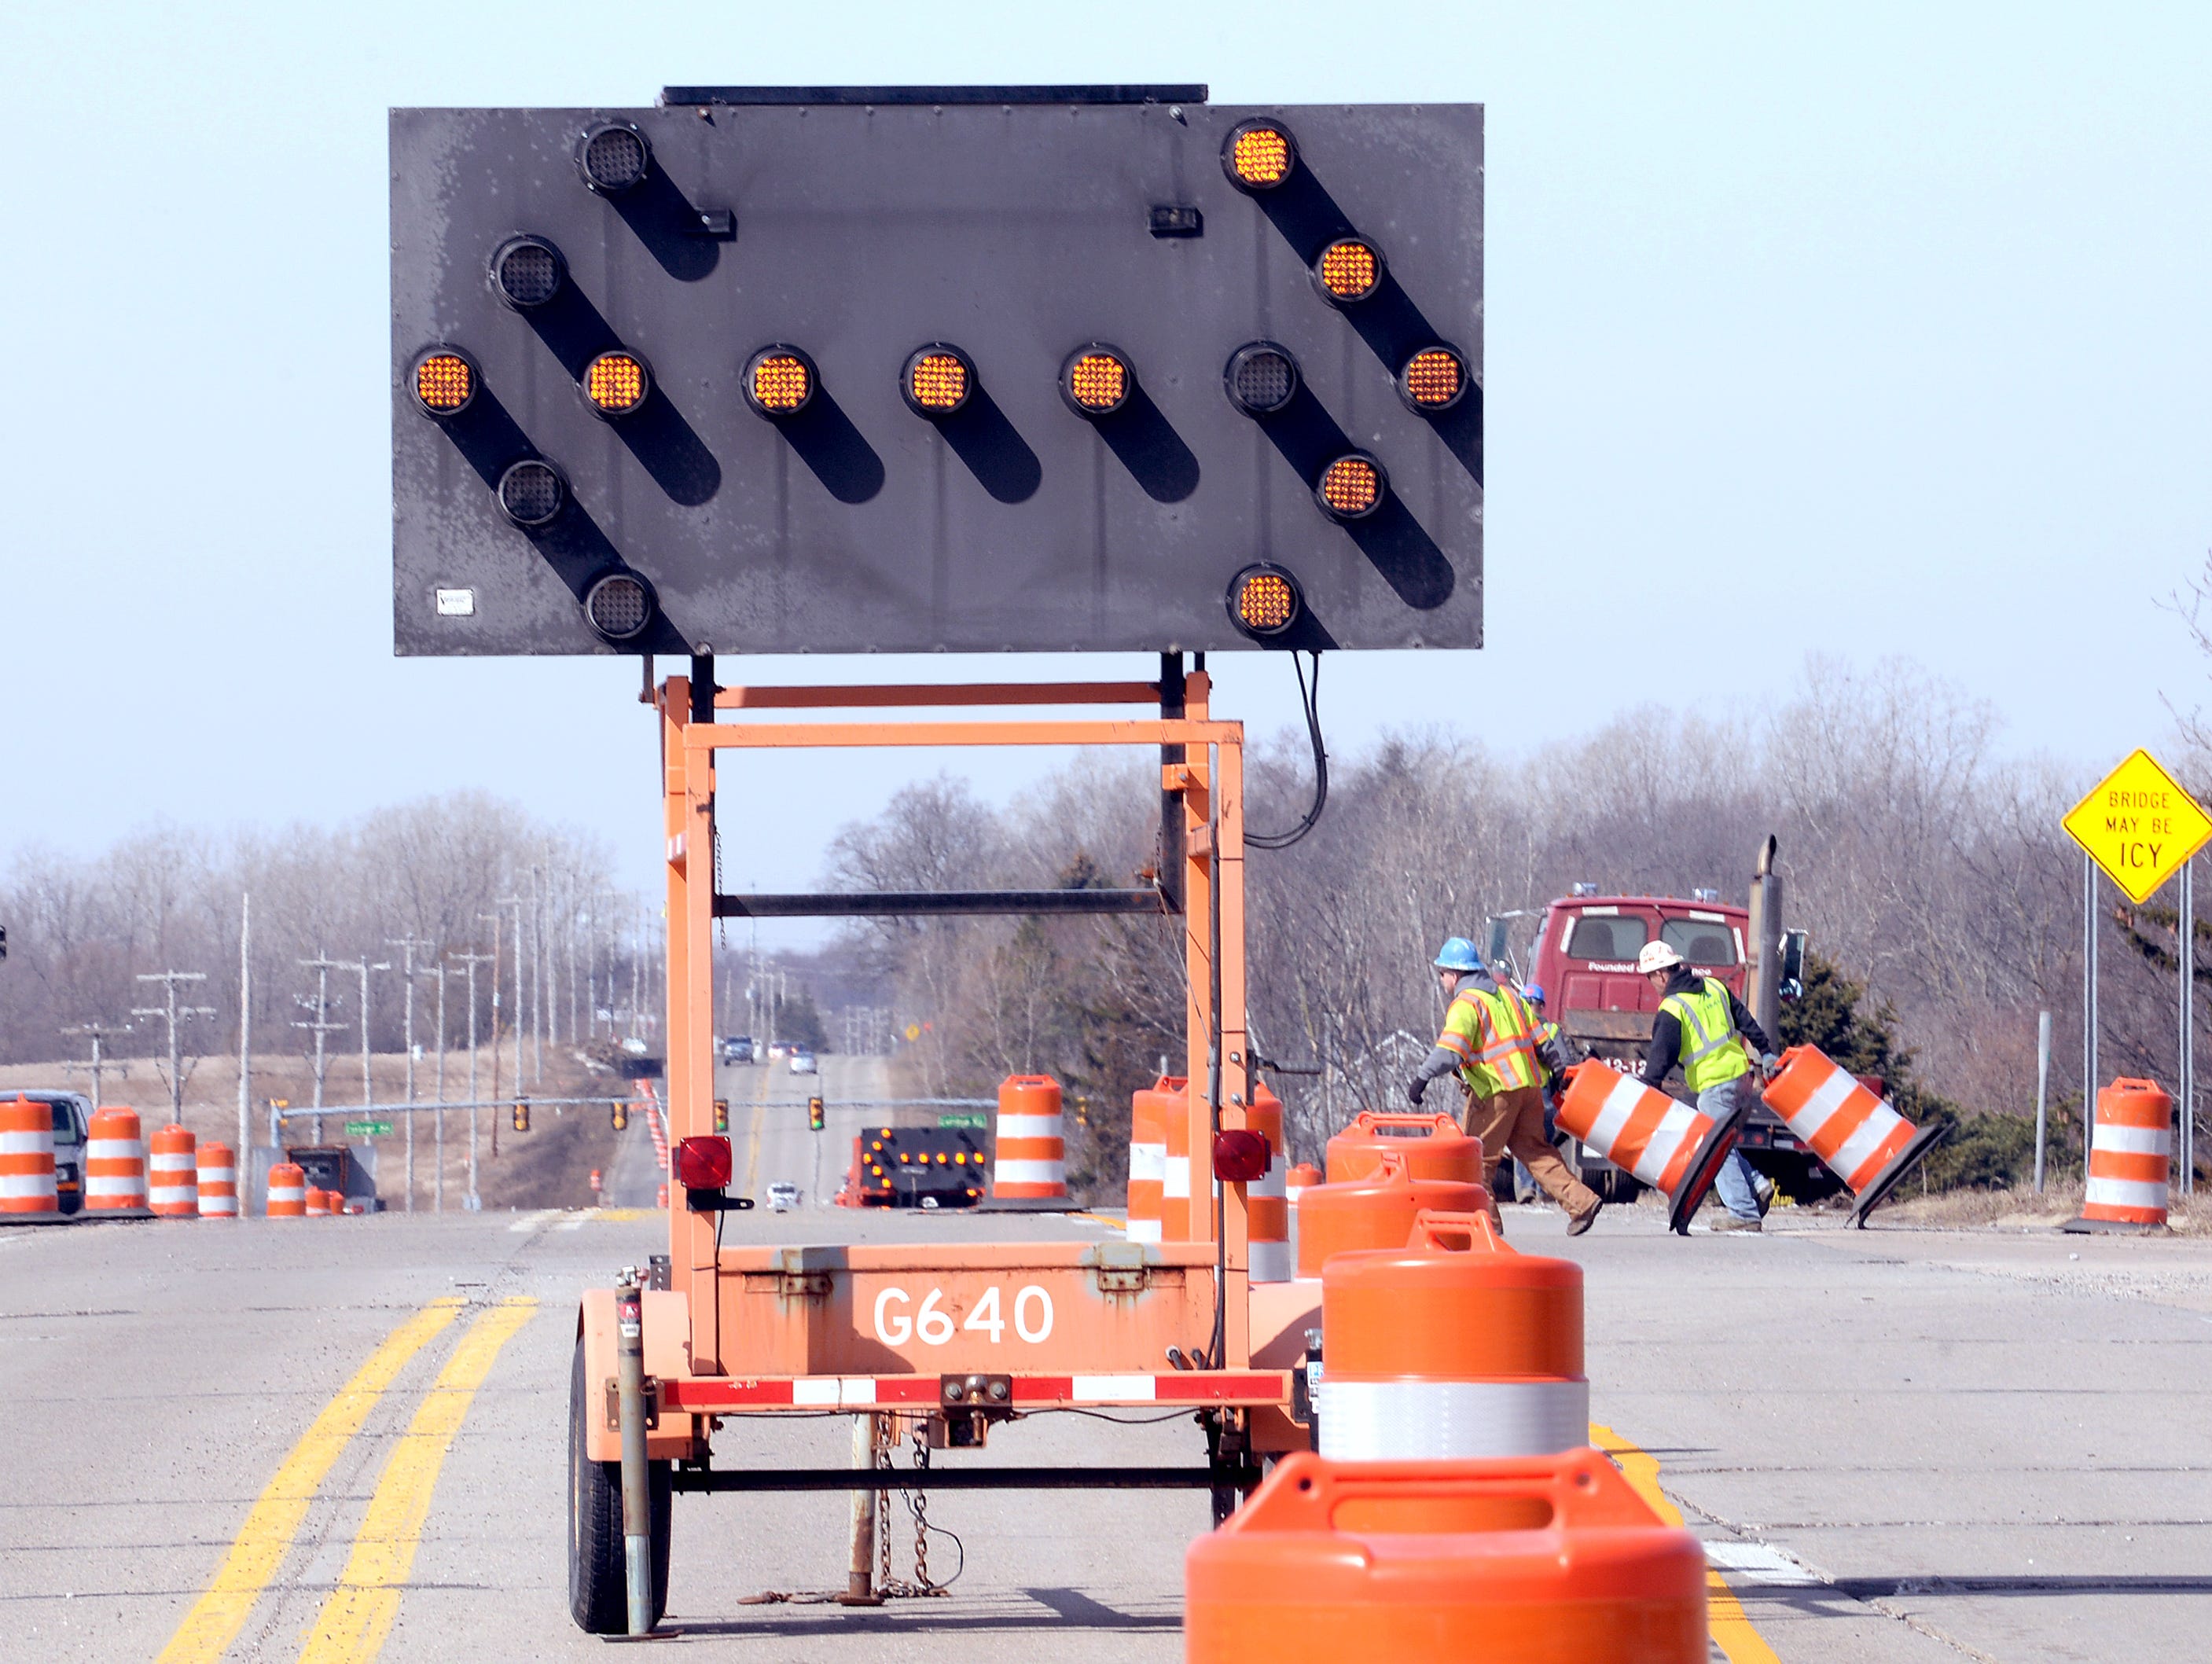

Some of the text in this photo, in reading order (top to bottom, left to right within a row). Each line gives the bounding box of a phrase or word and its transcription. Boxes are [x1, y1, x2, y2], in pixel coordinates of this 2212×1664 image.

[2110, 792, 2170, 809] BRIDGE
[2106, 817, 2172, 834] MAY BE
[2122, 843, 2162, 868] ICY
[874, 1285, 1054, 1346] G640
